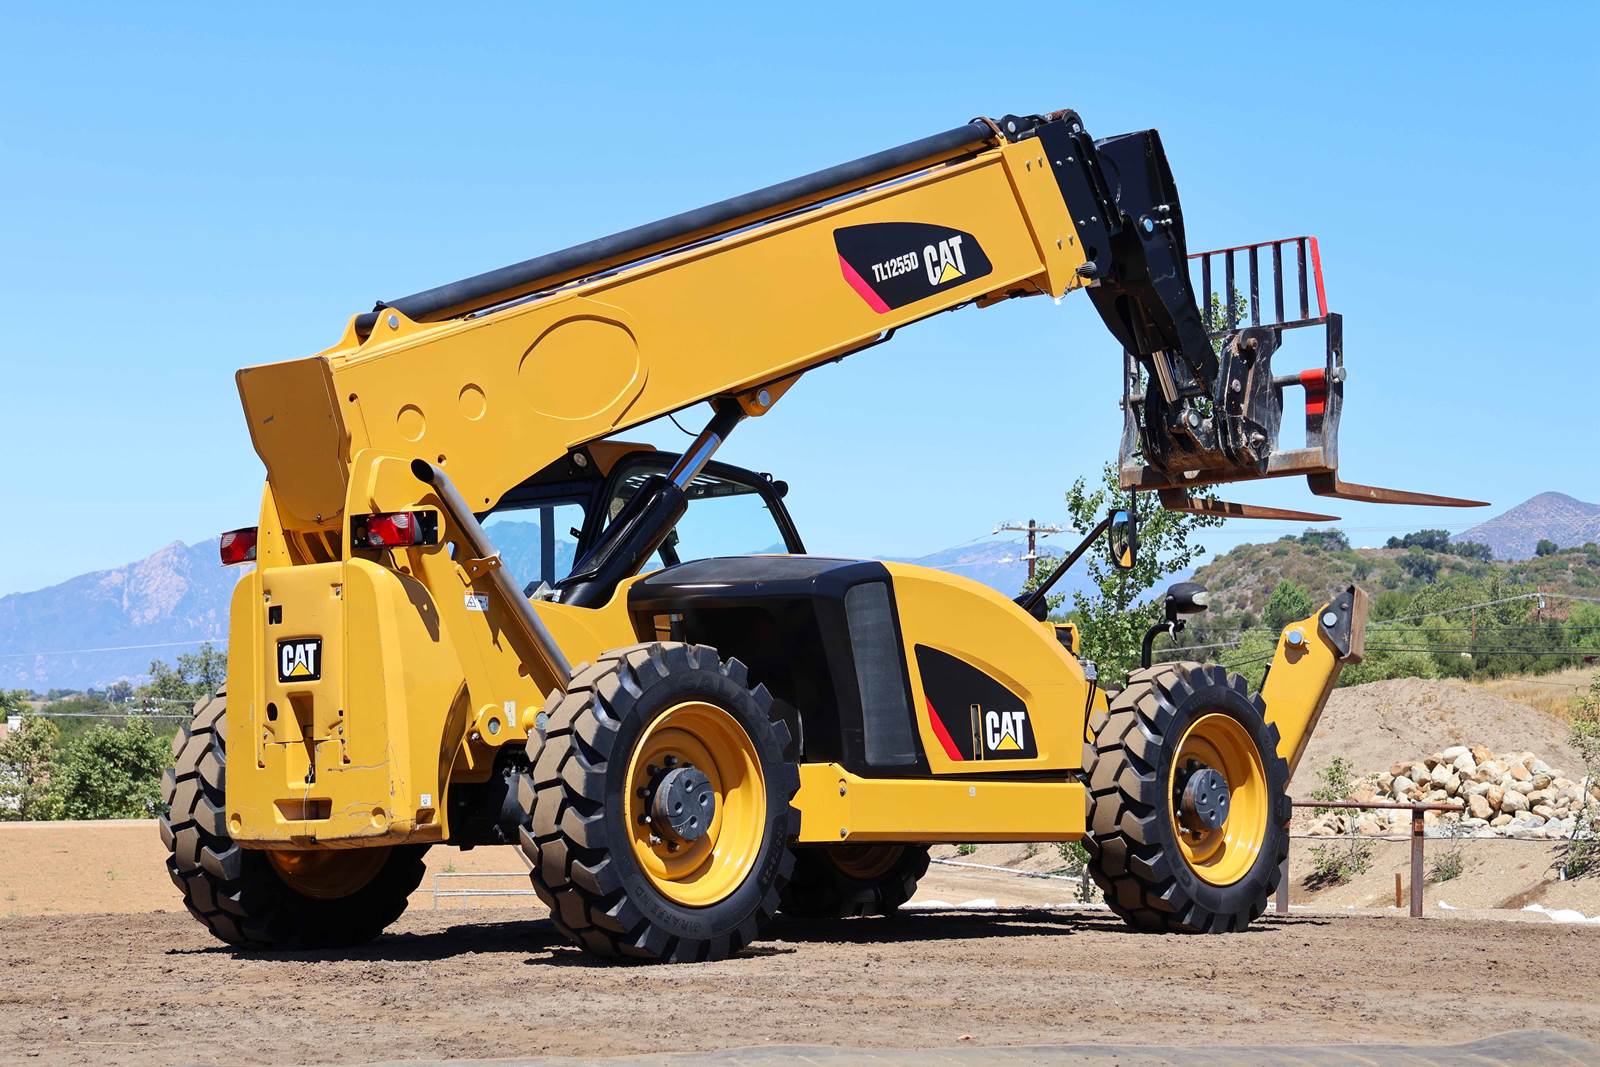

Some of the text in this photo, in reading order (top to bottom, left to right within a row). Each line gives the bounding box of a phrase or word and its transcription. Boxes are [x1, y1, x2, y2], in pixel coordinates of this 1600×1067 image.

[872, 235, 966, 286] TL1255D CAT
[282, 643, 317, 677] CAT
[985, 711, 1025, 751] CAT
